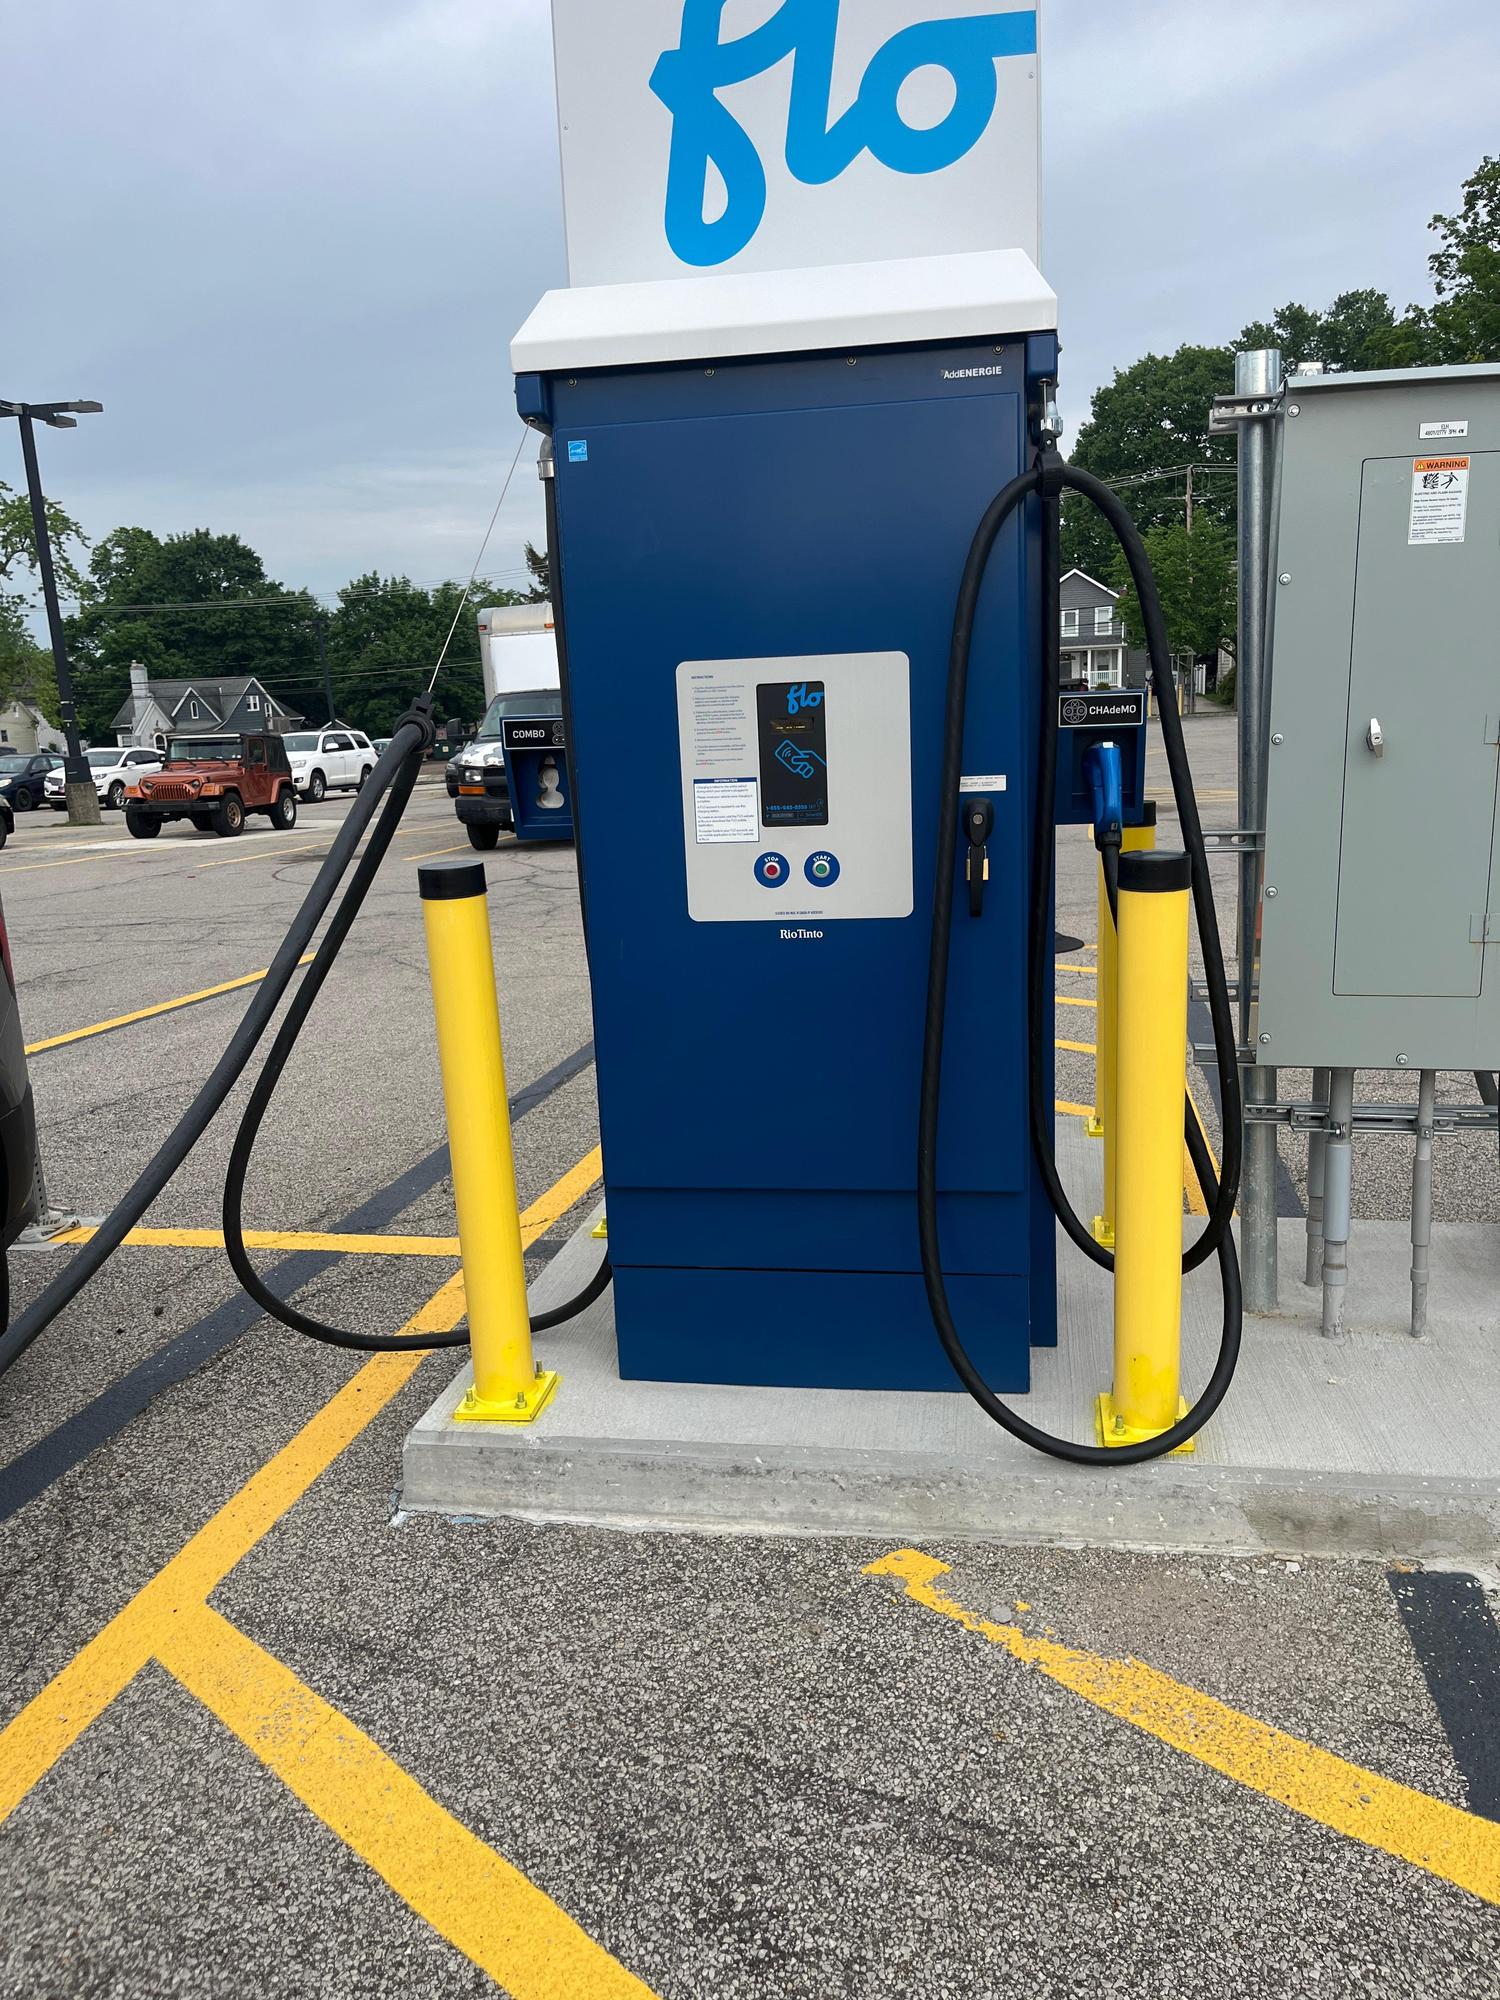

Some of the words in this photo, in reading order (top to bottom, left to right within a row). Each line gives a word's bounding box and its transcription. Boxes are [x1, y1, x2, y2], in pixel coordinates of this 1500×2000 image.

[649, 0, 1036, 266] flo
[943, 366, 1002, 379] AddENERGIE
[1426, 460, 1467, 470] WARNING
[786, 683, 825, 715] flo
[1089, 704, 1137, 715] CHAdeMO
[512, 729, 546, 739] COMBO
